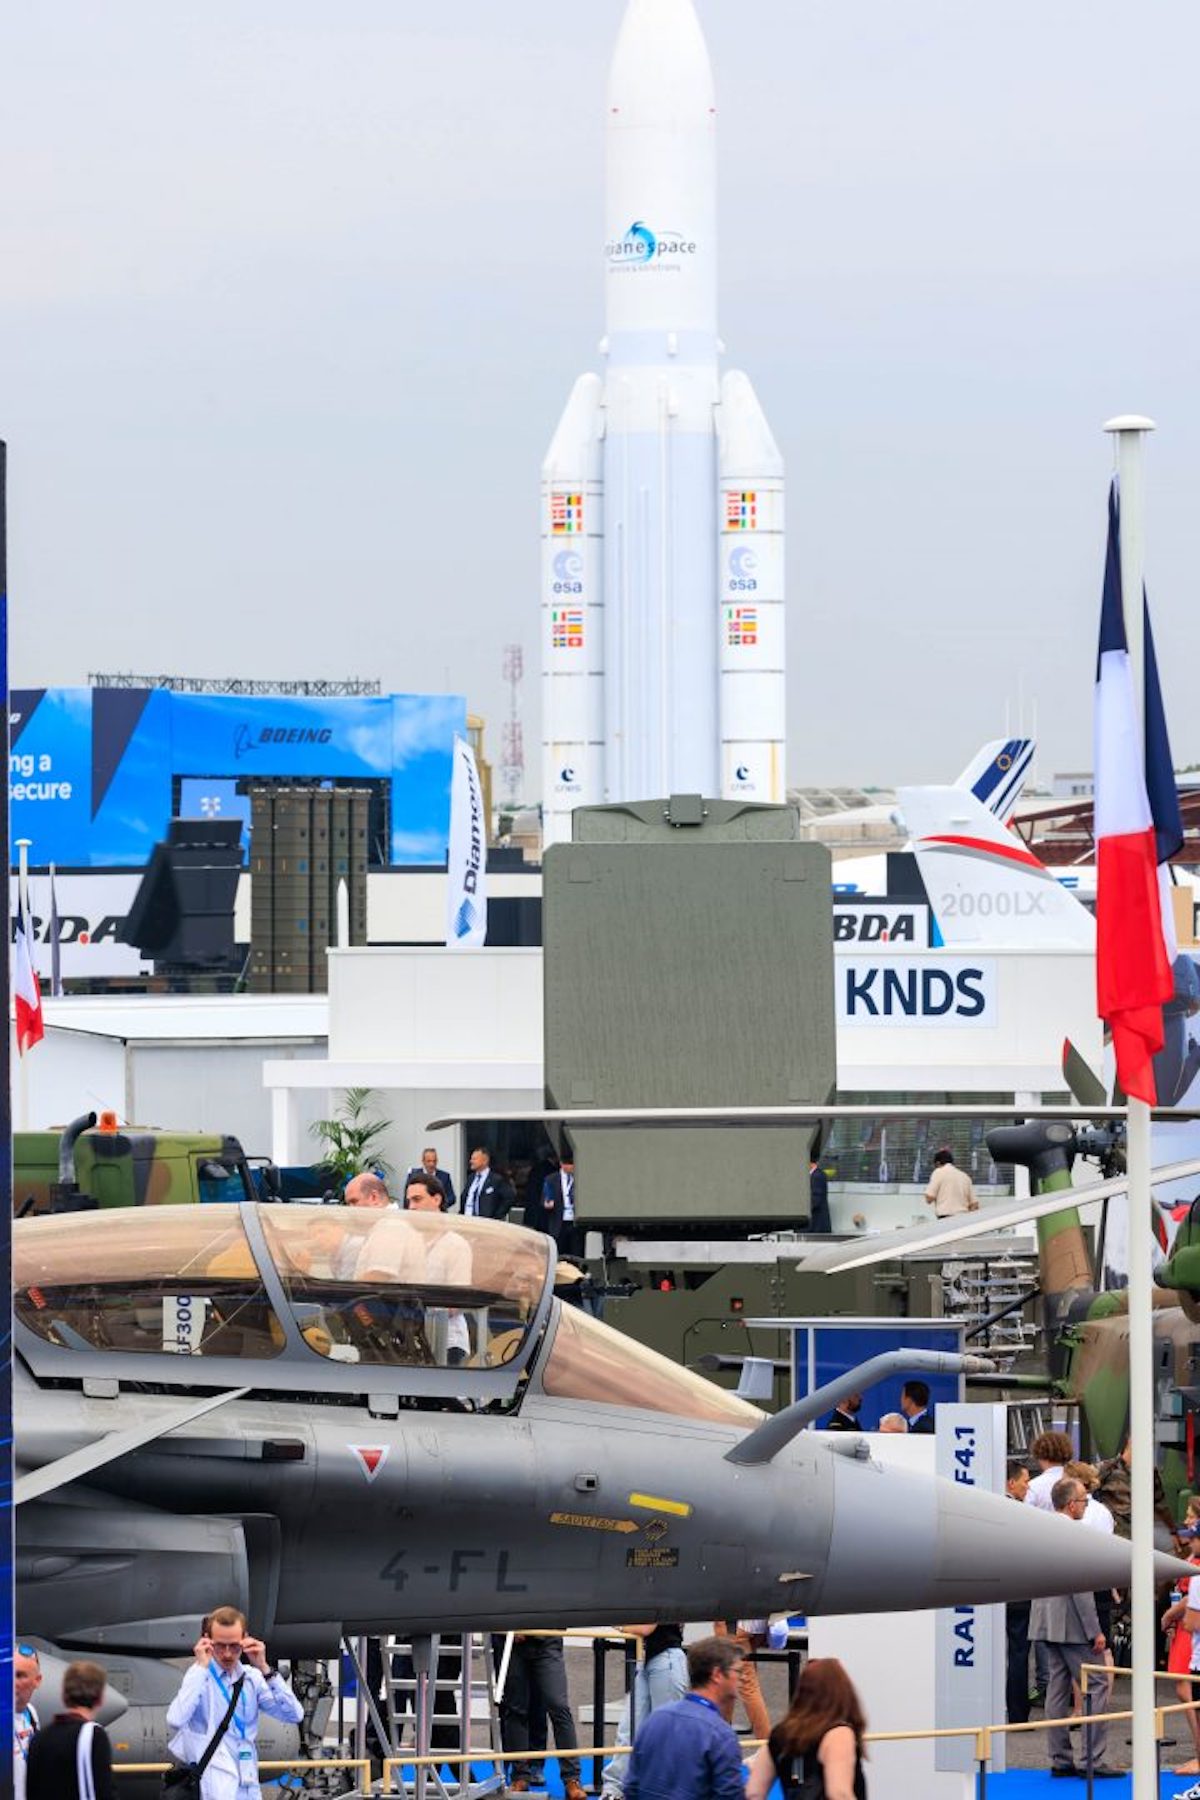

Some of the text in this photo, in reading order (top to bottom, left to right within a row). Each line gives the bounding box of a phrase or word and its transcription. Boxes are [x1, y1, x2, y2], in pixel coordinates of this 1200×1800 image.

[552, 581, 582, 594] esa
[729, 578, 757, 591] esa
[260, 727, 333, 743] BOEING
[9, 754, 52, 777] ng a
[10, 916, 127, 943] BDA
[833, 914, 914, 942] BDA
[846, 968, 986, 1017] KNDS
[954, 1426, 975, 1486] F4.1
[379, 1549, 528, 1592] 4-FL
